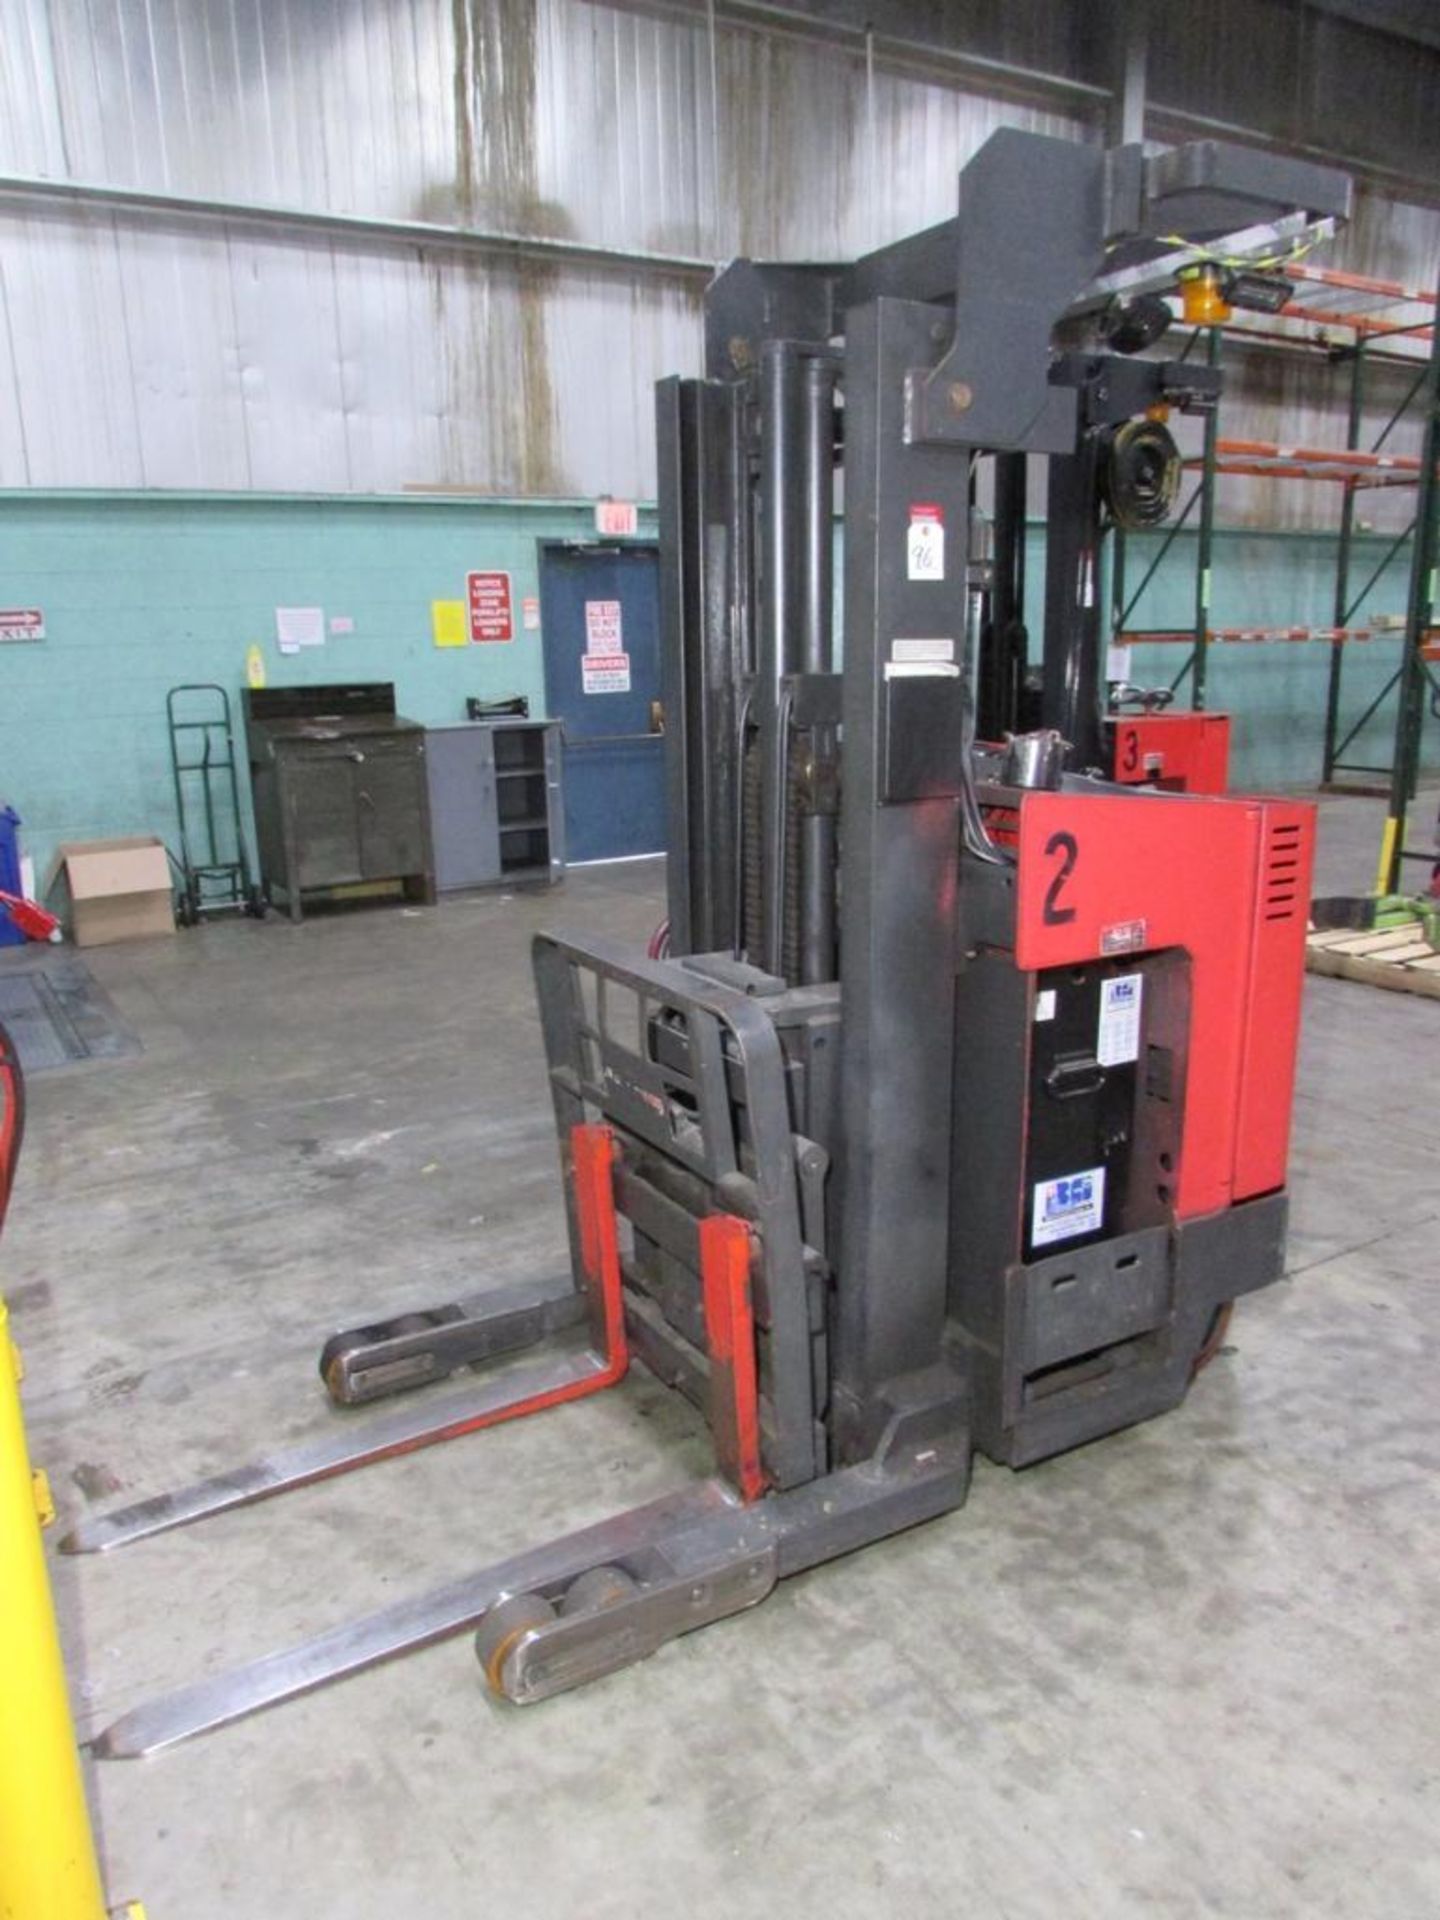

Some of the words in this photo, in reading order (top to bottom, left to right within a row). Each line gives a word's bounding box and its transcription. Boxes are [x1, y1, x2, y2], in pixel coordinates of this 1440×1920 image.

[911, 543, 933, 570] 96
[1123, 730, 1139, 772] 3
[1043, 831, 1079, 927] 2
